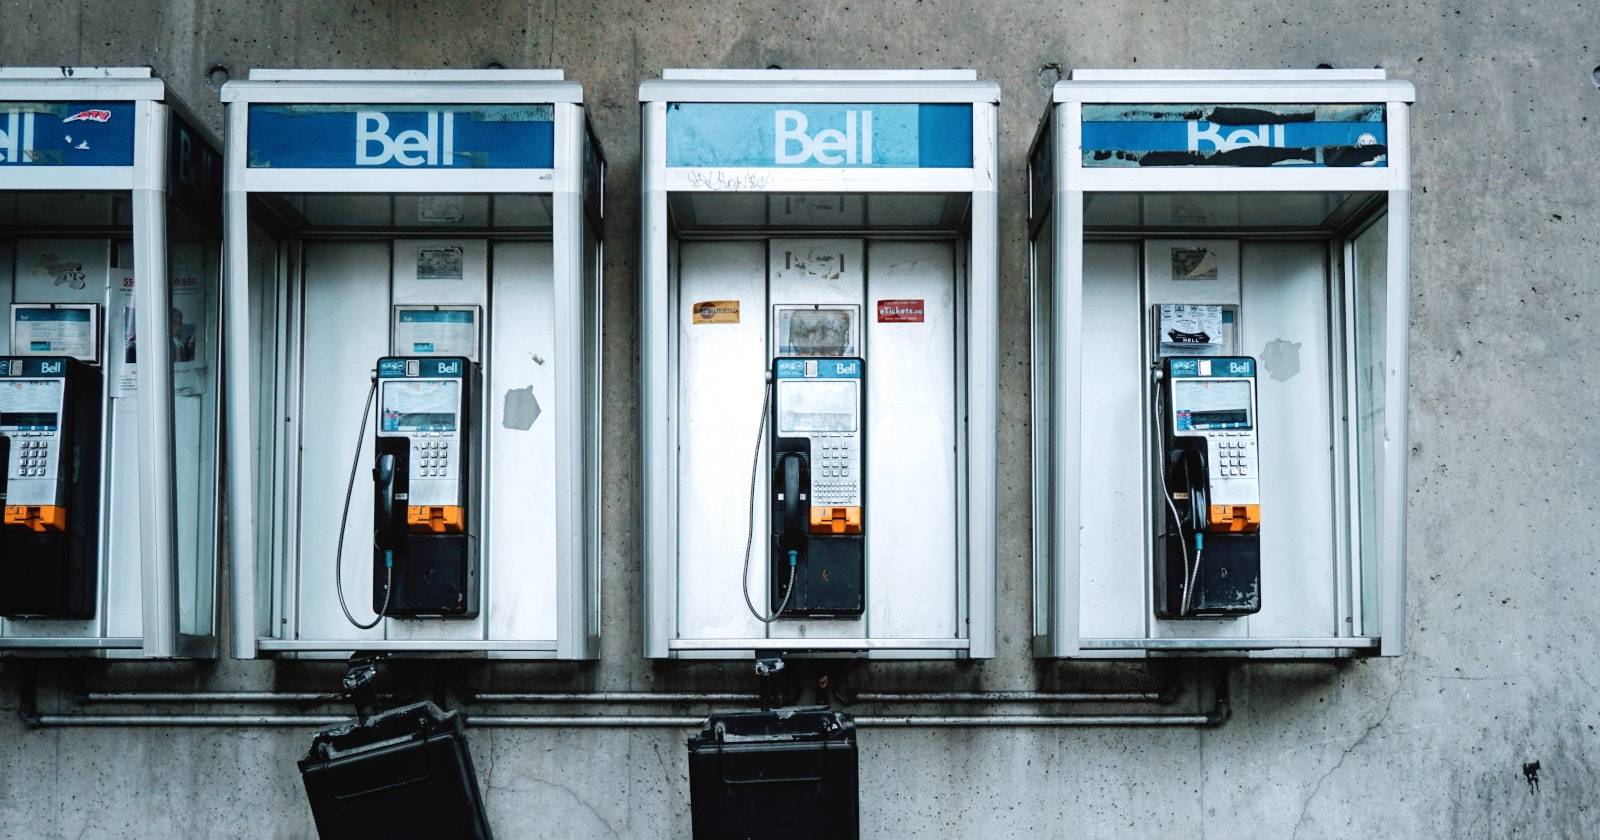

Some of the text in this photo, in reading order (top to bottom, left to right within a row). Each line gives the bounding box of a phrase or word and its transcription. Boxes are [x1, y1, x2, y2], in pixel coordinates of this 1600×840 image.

[0, 108, 34, 163] ll
[355, 111, 454, 167] Bell
[774, 109, 873, 165] Bell
[41, 361, 61, 374] Bell
[438, 361, 458, 374] Bell
[836, 362, 856, 375] Bell
[1229, 361, 1249, 374] Bell
